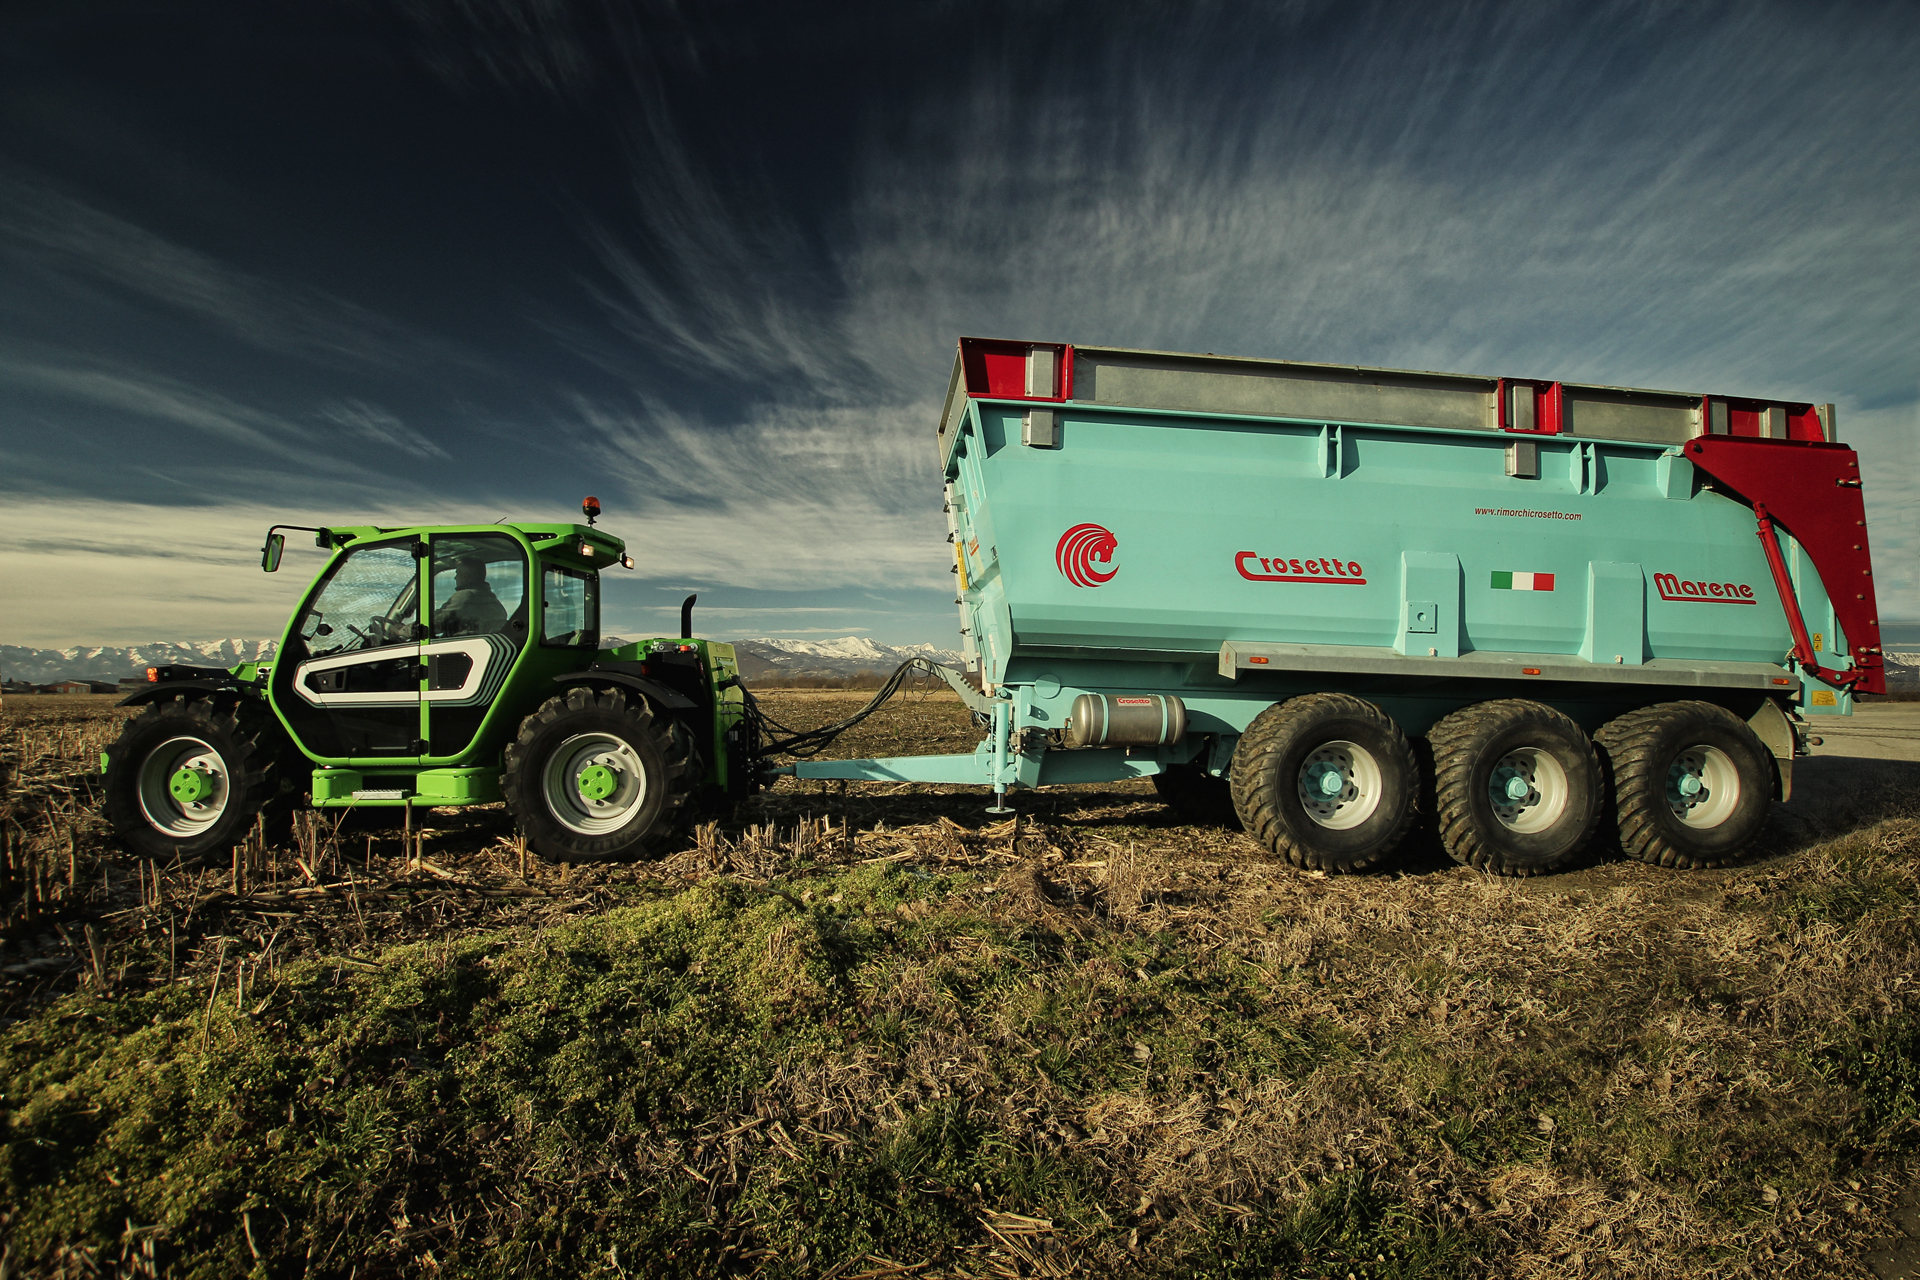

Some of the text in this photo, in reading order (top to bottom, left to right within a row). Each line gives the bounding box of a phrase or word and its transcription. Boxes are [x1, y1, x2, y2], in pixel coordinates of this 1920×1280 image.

[1474, 507, 1582, 521] www.rimorchicrosetto.com
[1234, 551, 1367, 585] Crosetto
[1653, 572, 1757, 605] Marene
